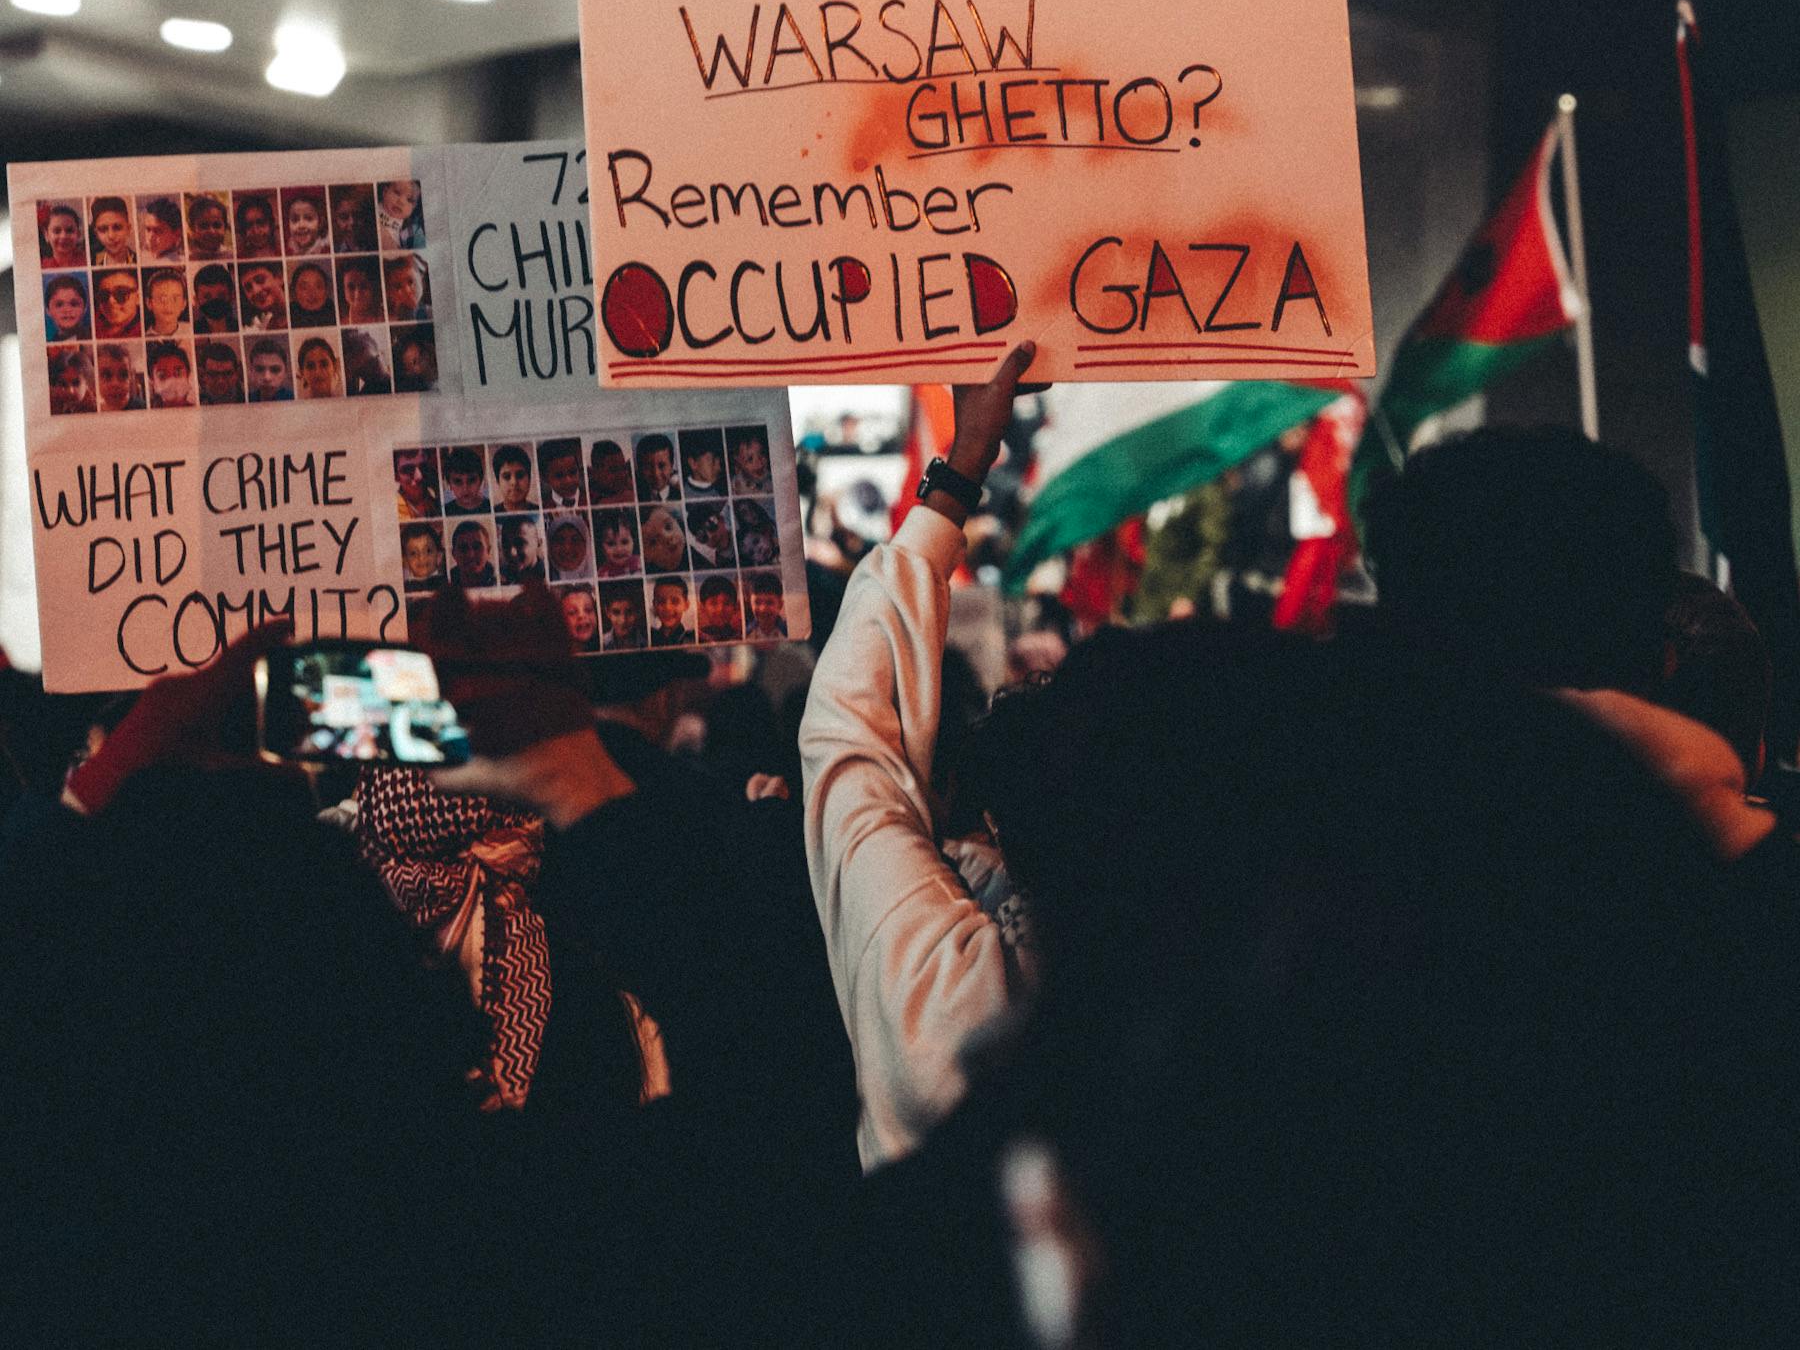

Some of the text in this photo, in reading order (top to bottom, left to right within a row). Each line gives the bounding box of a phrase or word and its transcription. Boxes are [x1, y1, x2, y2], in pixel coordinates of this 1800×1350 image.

[905, 64, 1223, 149] GHETTO?
[608, 149, 1013, 234] Remember
[601, 236, 1333, 358] OCCUPIED GAZA
[34, 450, 353, 530] WHAT CRIME
[88, 517, 359, 594] DID THEY
